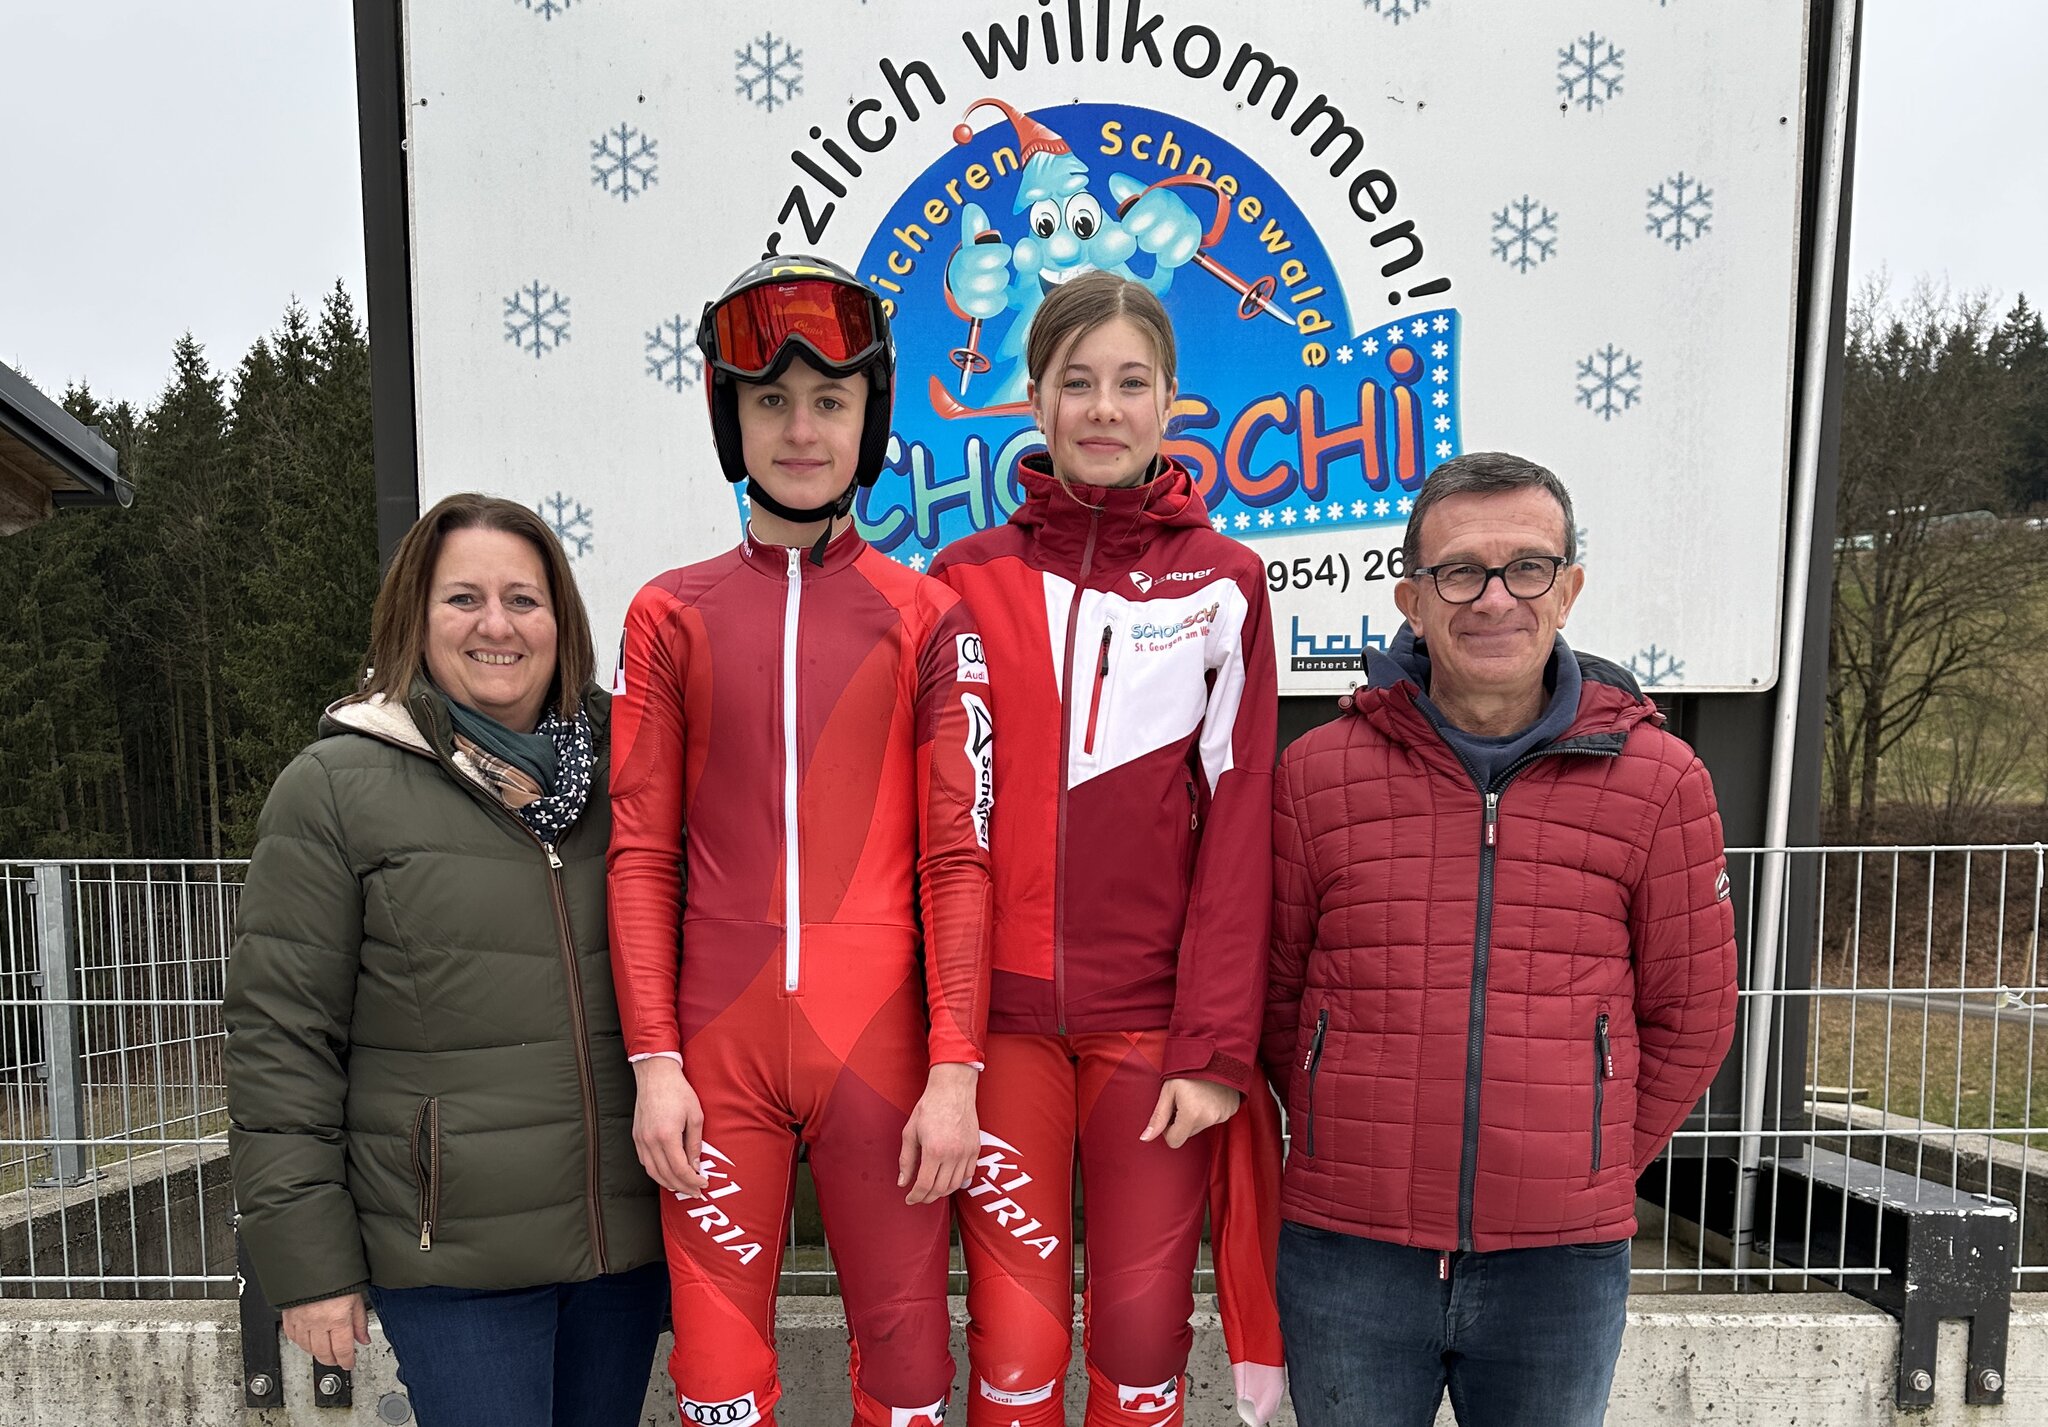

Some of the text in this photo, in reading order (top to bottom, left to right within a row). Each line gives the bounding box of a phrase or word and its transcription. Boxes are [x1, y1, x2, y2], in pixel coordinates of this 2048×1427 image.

[962, 0, 1451, 306] willkommen!
[1100, 121, 1333, 367] Schneewalde
[1154, 567, 1216, 586] iener
[1185, 630, 1198, 640] am
[1297, 660, 1348, 670] Herbert
[964, 670, 986, 681] Audi
[967, 1176, 1060, 1260] TRIA
[986, 1392, 1013, 1404] Audi
